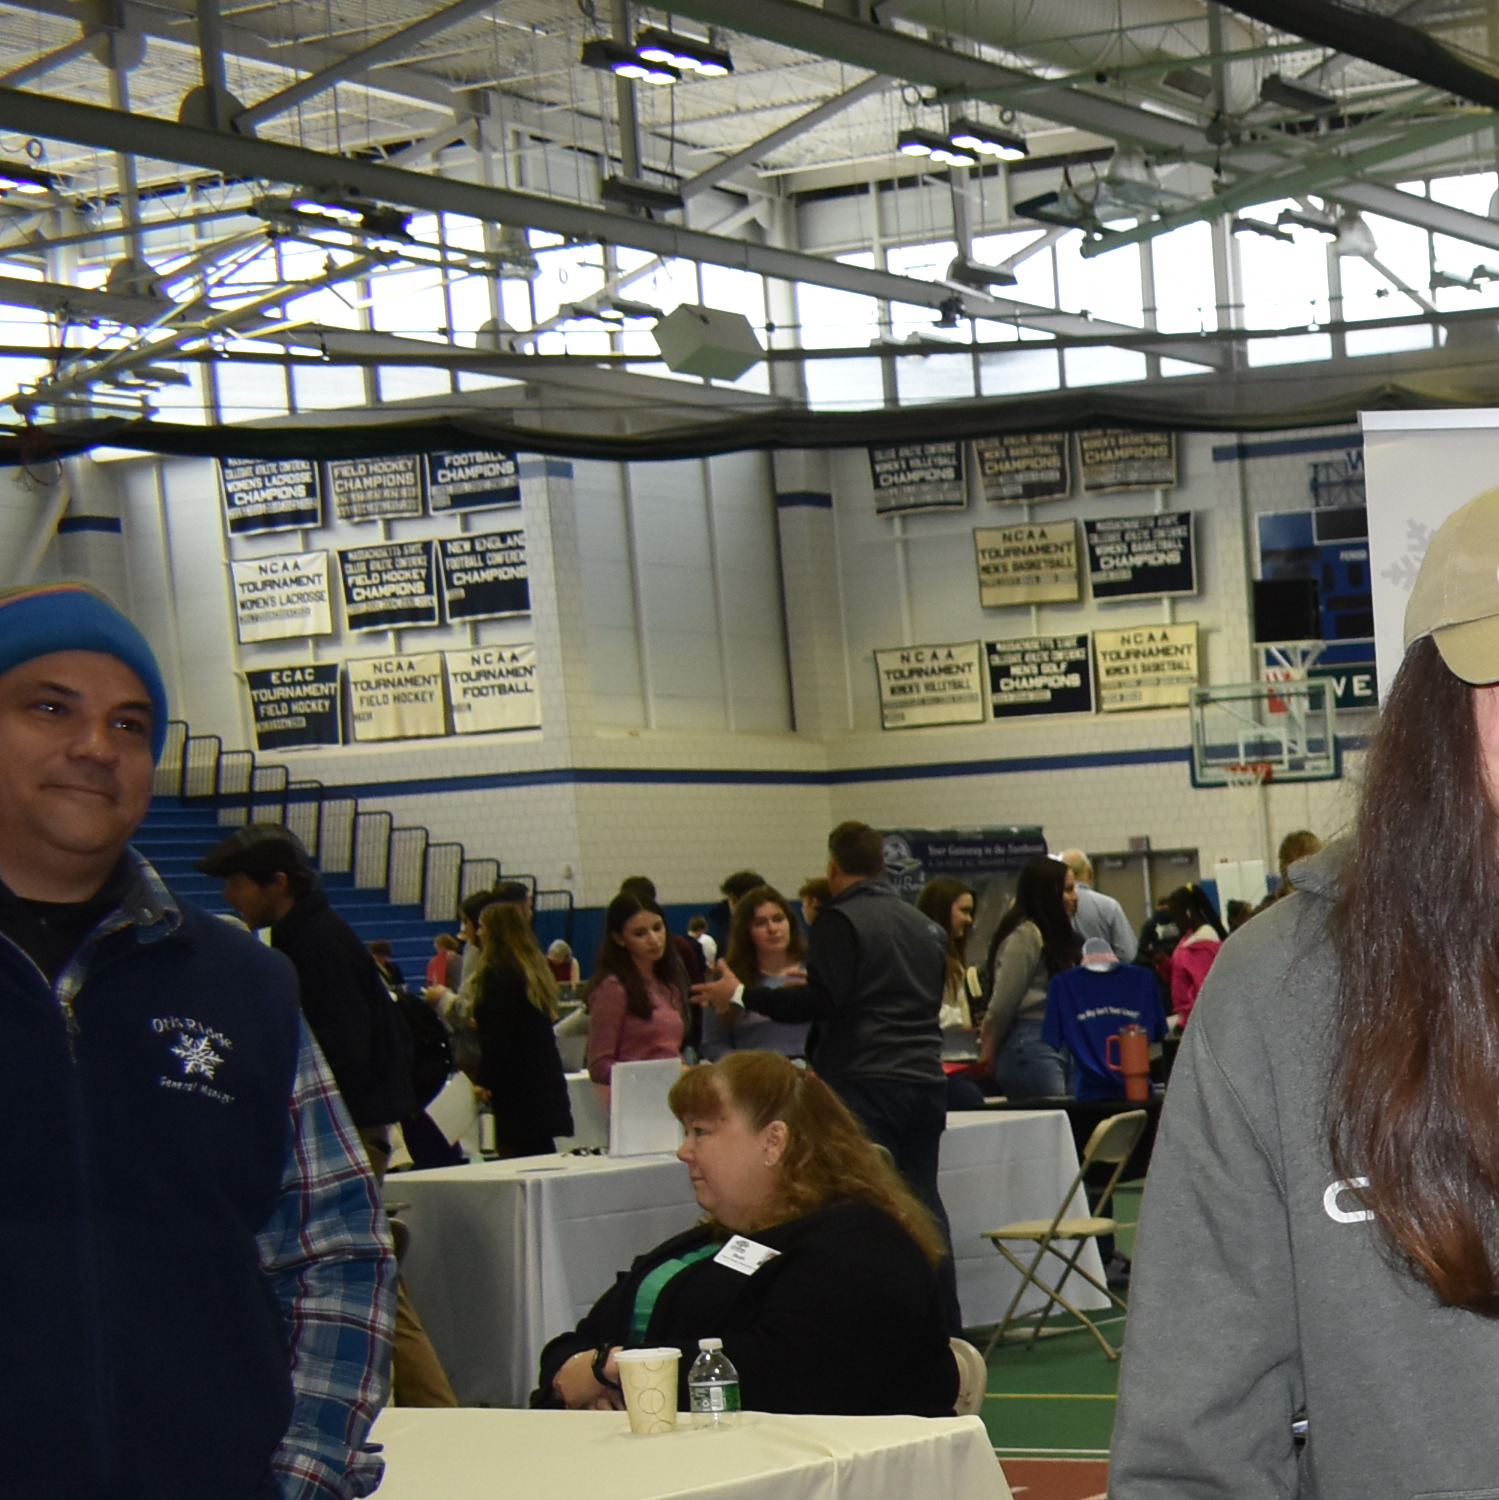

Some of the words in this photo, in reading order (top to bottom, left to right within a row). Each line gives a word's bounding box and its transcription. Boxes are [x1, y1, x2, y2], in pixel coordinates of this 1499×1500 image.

[445, 451, 507, 467] FOOTBALL
[1085, 445, 1168, 465] CHAMPIONS
[333, 463, 366, 478] FIELD
[369, 459, 414, 473] HOCKEY
[437, 461, 515, 483] CHAMPIONS
[983, 455, 1061, 475] CHAMPIONS
[335, 472, 415, 493] CHAMPIONS
[878, 467, 956, 487] CHAMPIONS
[234, 485, 306, 505] CHAMPIONS
[474, 533, 526, 552] ENGLAN
[1002, 529, 1048, 543] NCAA
[981, 543, 1075, 560] TOURNAMENT
[1099, 551, 1181, 570] CHAMPIONS
[259, 561, 301, 575] NCAA
[347, 572, 380, 587] FIELD
[383, 567, 427, 583] HOCKEY
[239, 573, 324, 594] TOURNAMENT
[353, 581, 425, 601] CHAMPIONS
[279, 590, 326, 606] LACROSSE
[1121, 631, 1169, 645] NCAA
[471, 652, 520, 667] NCAA
[901, 650, 955, 664] NCAA
[1100, 644, 1193, 661] TOURNAMENT
[271, 670, 315, 684] ECAC
[373, 662, 416, 675] NCAA
[885, 662, 973, 681] TOURNAMENT
[353, 673, 440, 692] TOURNAMENT
[462, 681, 534, 699] FOOTBALL
[1000, 674, 1081, 691] CHAMPIONS
[251, 683, 338, 702] TOURNAMENT
[360, 692, 389, 707] FIELD
[393, 690, 435, 705] HOCKEY
[260, 703, 288, 718] FIELD
[291, 699, 331, 715] HOCKEY
[151, 1016, 184, 1034] Otis
